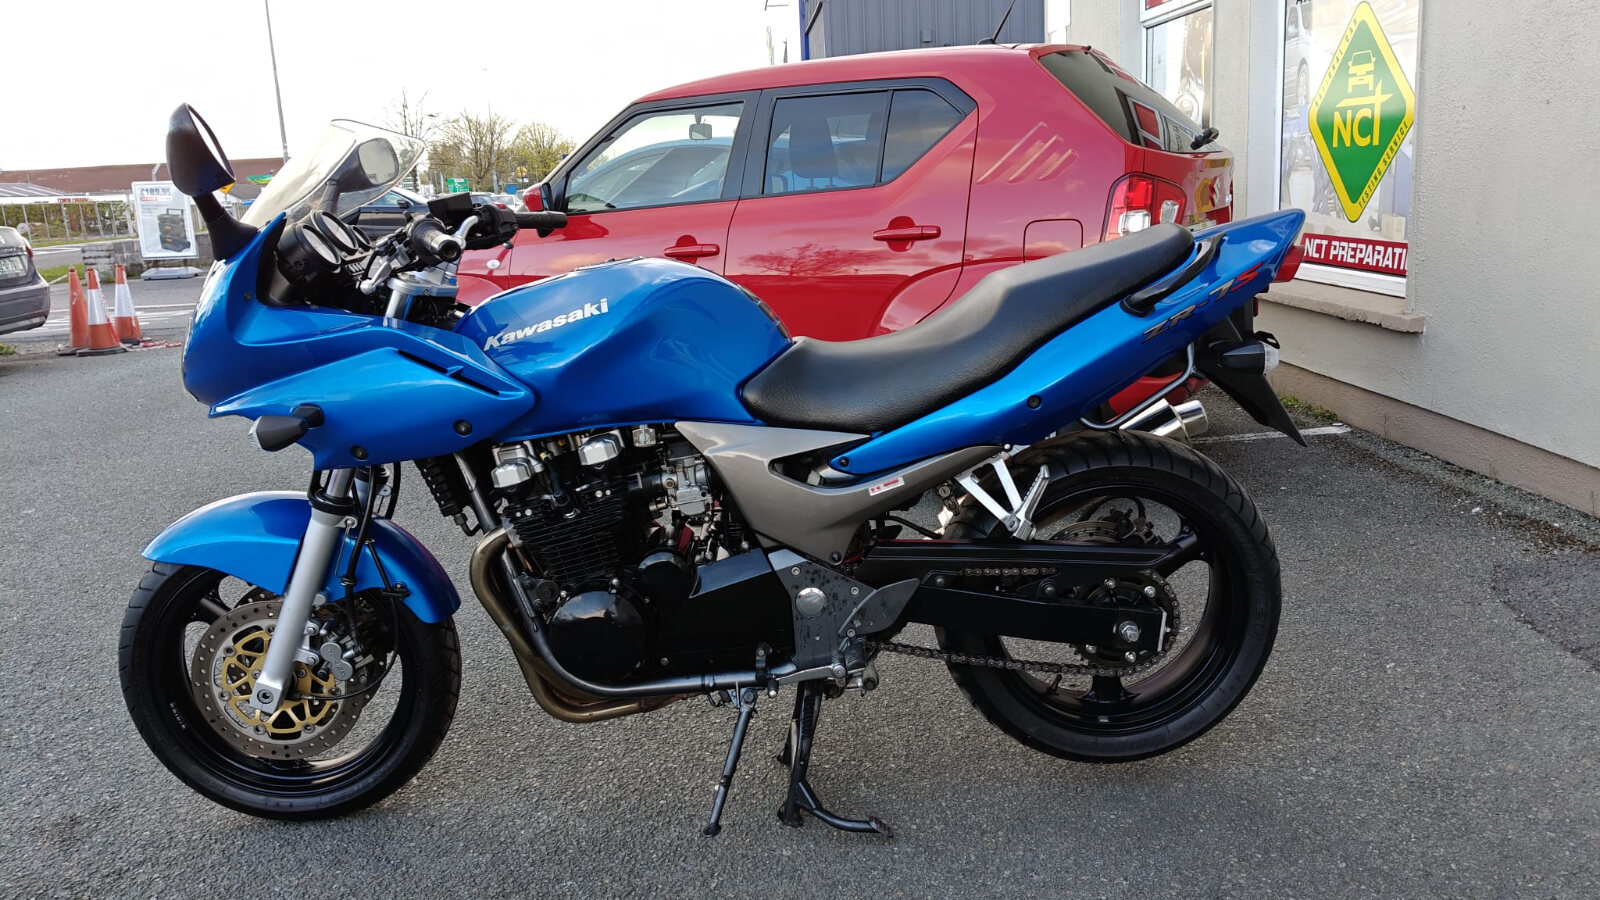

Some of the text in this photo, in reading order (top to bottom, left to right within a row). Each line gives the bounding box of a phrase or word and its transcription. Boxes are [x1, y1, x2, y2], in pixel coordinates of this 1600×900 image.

[1313, 48, 1344, 108] NATIONAL
[1332, 83, 1394, 148] NCT
[1358, 121, 1408, 209] TESTING SERVICE
[1304, 238, 1408, 271] NCT PREPARATI
[483, 298, 609, 351] Kawasaki
